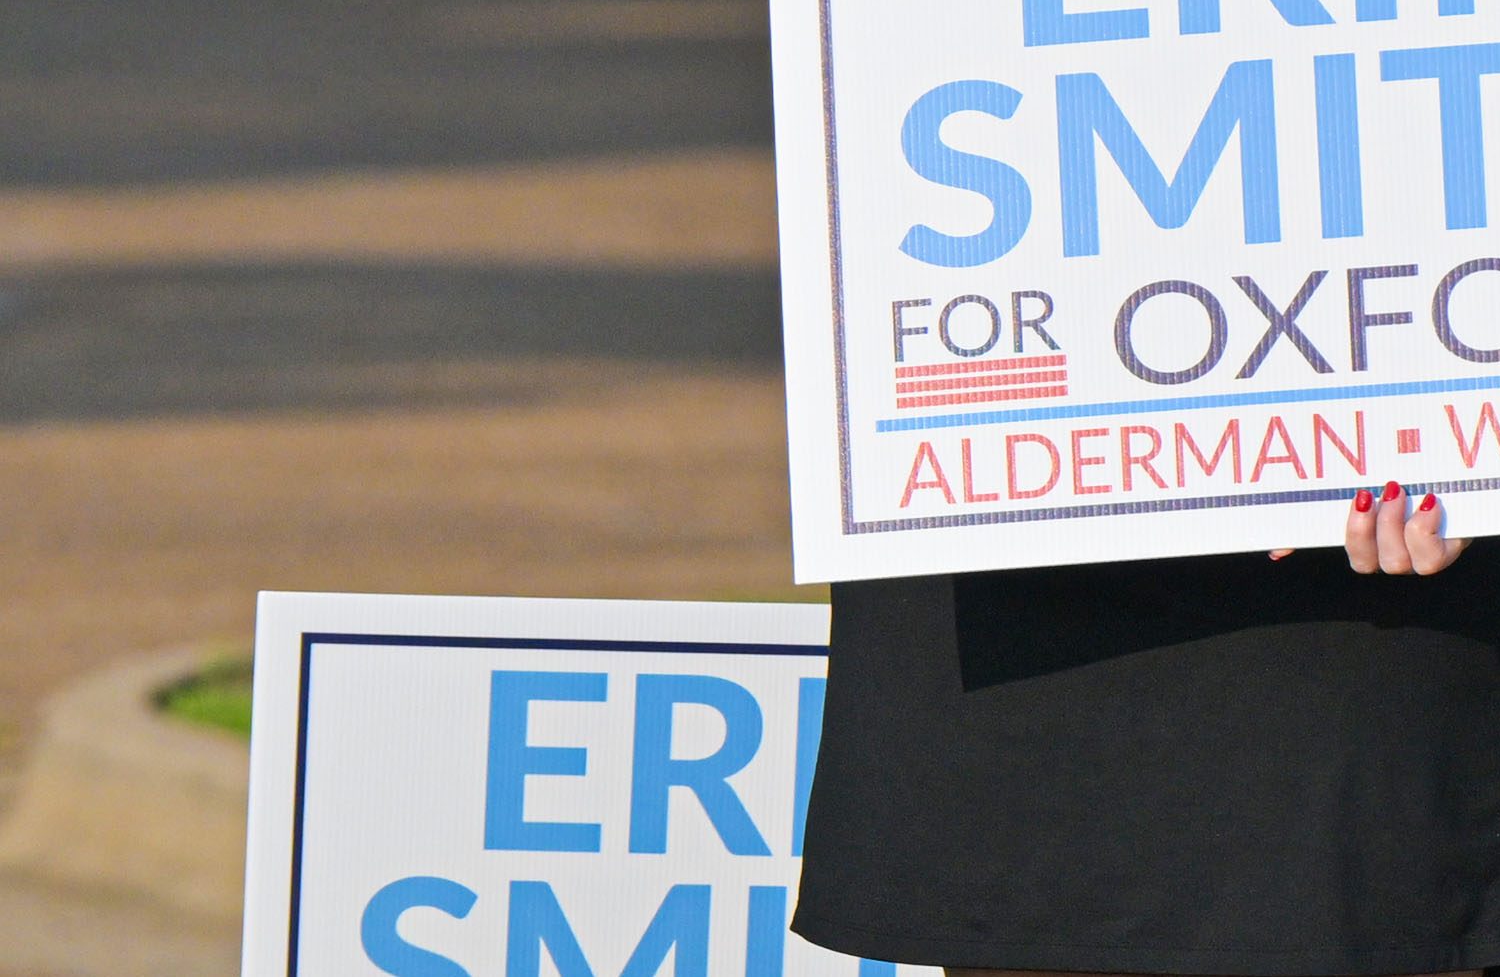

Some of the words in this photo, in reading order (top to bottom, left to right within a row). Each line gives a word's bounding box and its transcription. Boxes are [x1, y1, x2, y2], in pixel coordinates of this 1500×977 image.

[892, 290, 1061, 362] FOR
[899, 410, 1367, 509] ALDERMAN
[483, 669, 828, 859] ERI
[361, 875, 898, 977] SMI
